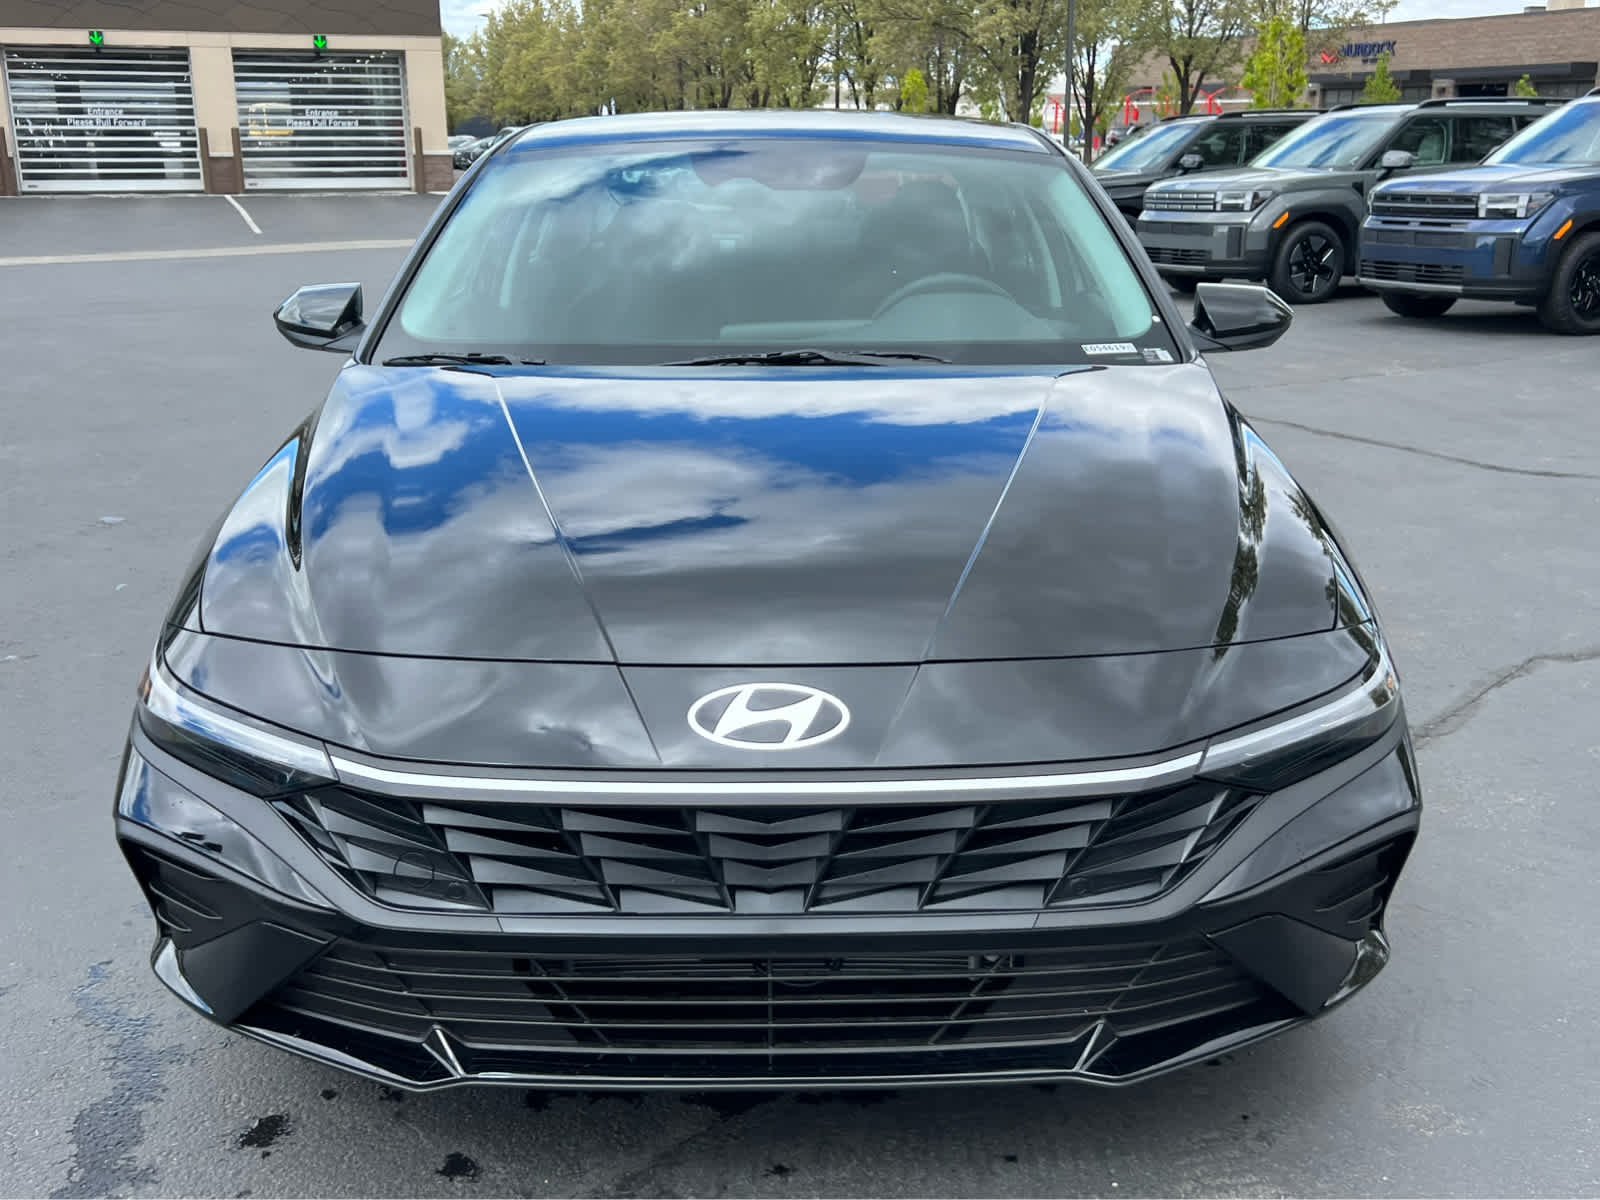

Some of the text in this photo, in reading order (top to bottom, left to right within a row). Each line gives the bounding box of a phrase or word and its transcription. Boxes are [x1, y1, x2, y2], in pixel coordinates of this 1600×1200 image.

[87, 108, 124, 116] Entrance
[305, 108, 339, 117] Entrance
[66, 117, 147, 127] Please Pull Forward
[286, 119, 359, 128] Please Pull Forward
